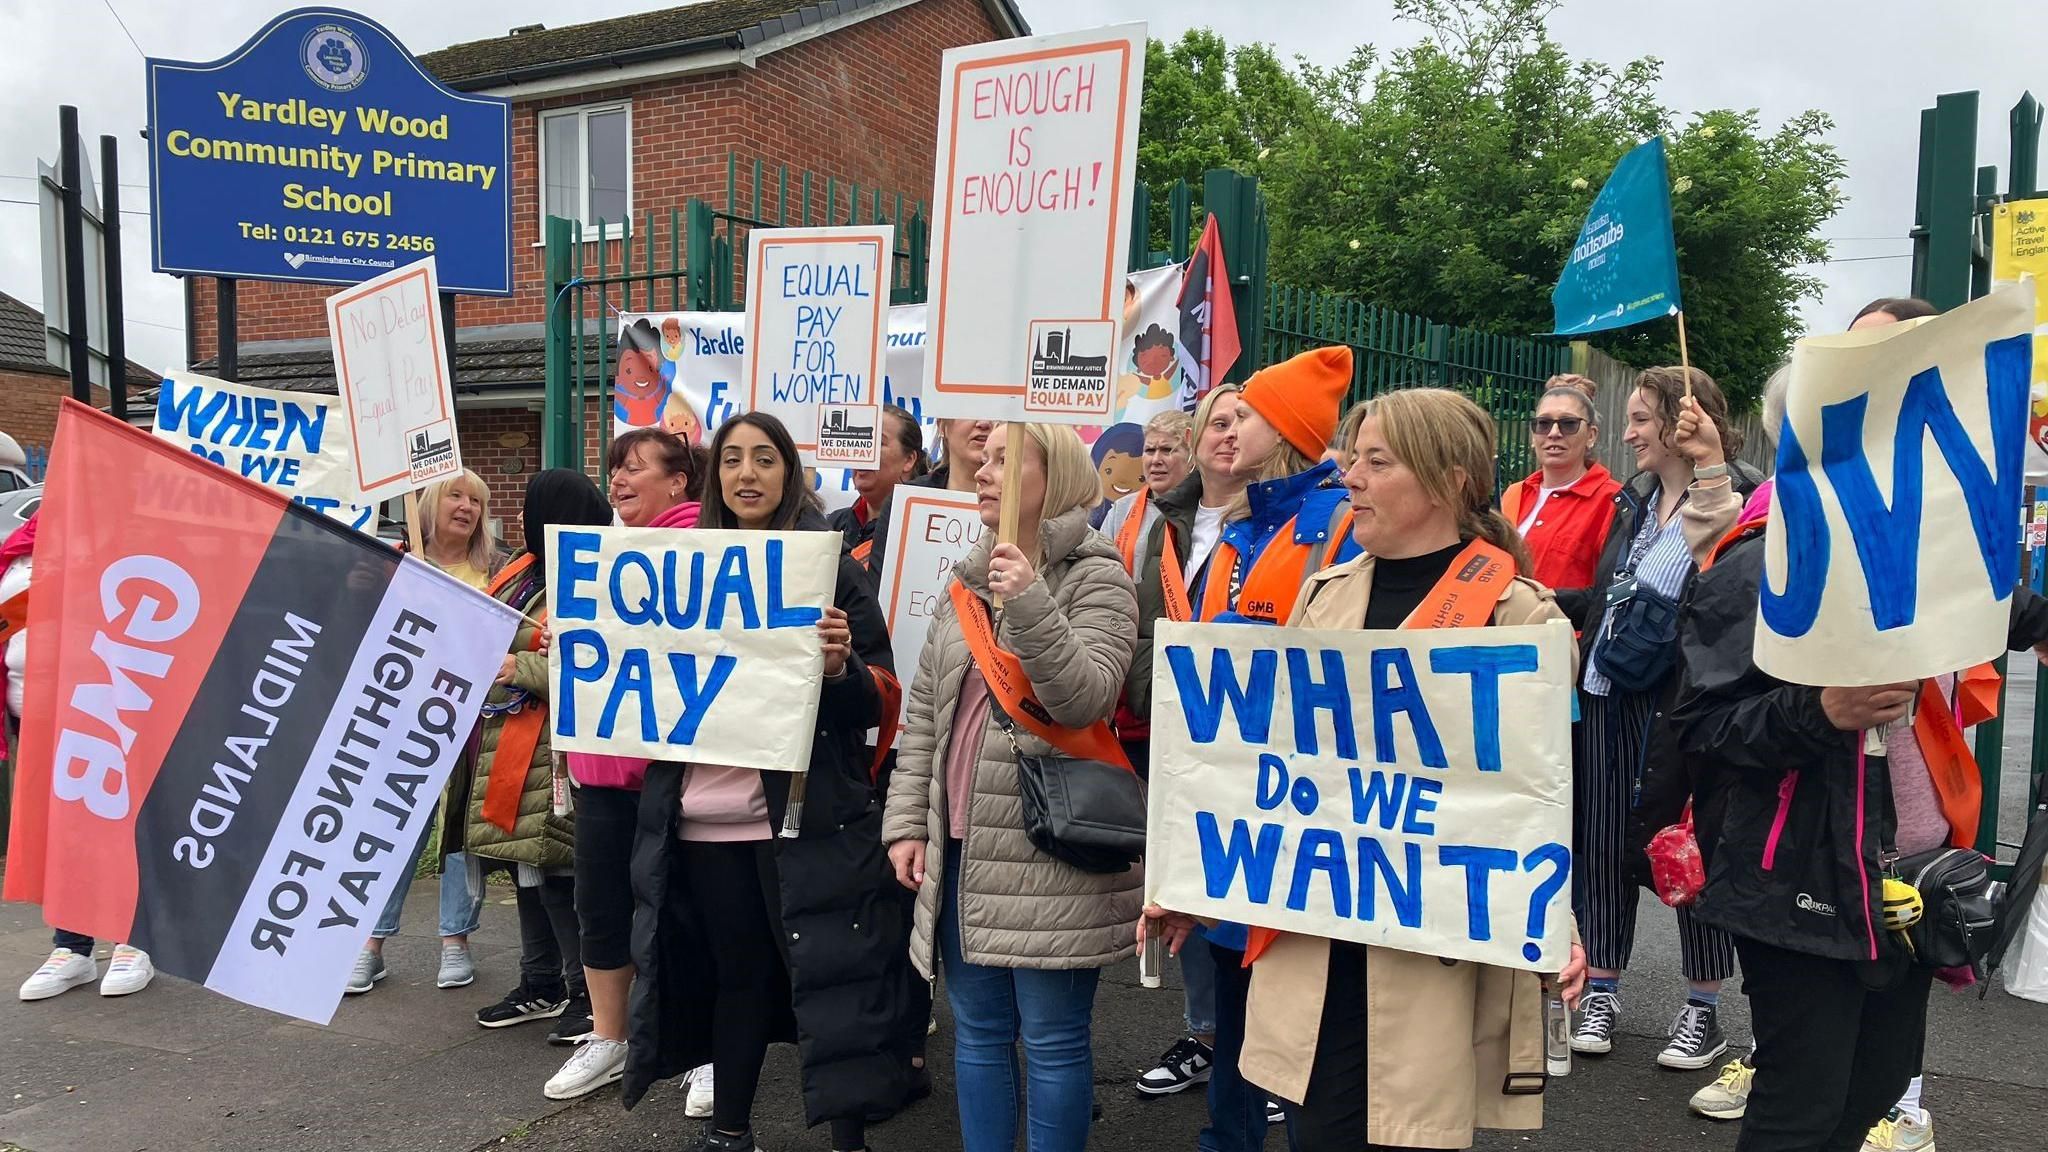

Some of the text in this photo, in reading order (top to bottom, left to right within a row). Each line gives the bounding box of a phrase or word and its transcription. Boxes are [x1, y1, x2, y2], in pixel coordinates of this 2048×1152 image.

[974, 63, 1096, 121] ENOUGH
[217, 91, 449, 140] Yardley Wood
[166, 130, 497, 190] Community Primary
[1008, 126, 1033, 167] IS
[283, 183, 392, 217] School
[238, 221, 435, 252] Tel: 0121 675 2456
[2016, 225, 2047, 235] Active
[2016, 234, 2045, 246] Travel
[305, 254, 395, 267] Birmingham City Council
[782, 263, 870, 299] EQUAL
[349, 284, 427, 349] No Delay
[797, 305, 843, 338] PAY
[793, 340, 835, 374] FOR
[355, 354, 436, 438] Equal Pay
[773, 373, 860, 405] WOMEN
[1030, 391, 1104, 407] EQUAL PAY
[1031, 377, 1105, 391] WE DEMAND
[157, 378, 328, 455] WHEN
[820, 448, 872, 458] EQUAL PAY
[821, 439, 873, 448] WE DEMAND
[241, 454, 300, 486] WE
[412, 452, 454, 470] WE DEMAND
[413, 460, 454, 480] EQUAL PAY
[556, 531, 823, 631] EQUAL
[1478, 562, 1503, 583] GMB
[1248, 600, 1274, 613] GMB
[556, 629, 738, 746] PAY
[1165, 645, 1539, 772] WHAT
[1347, 767, 1444, 836] WE
[1195, 811, 1571, 963] WANT?
